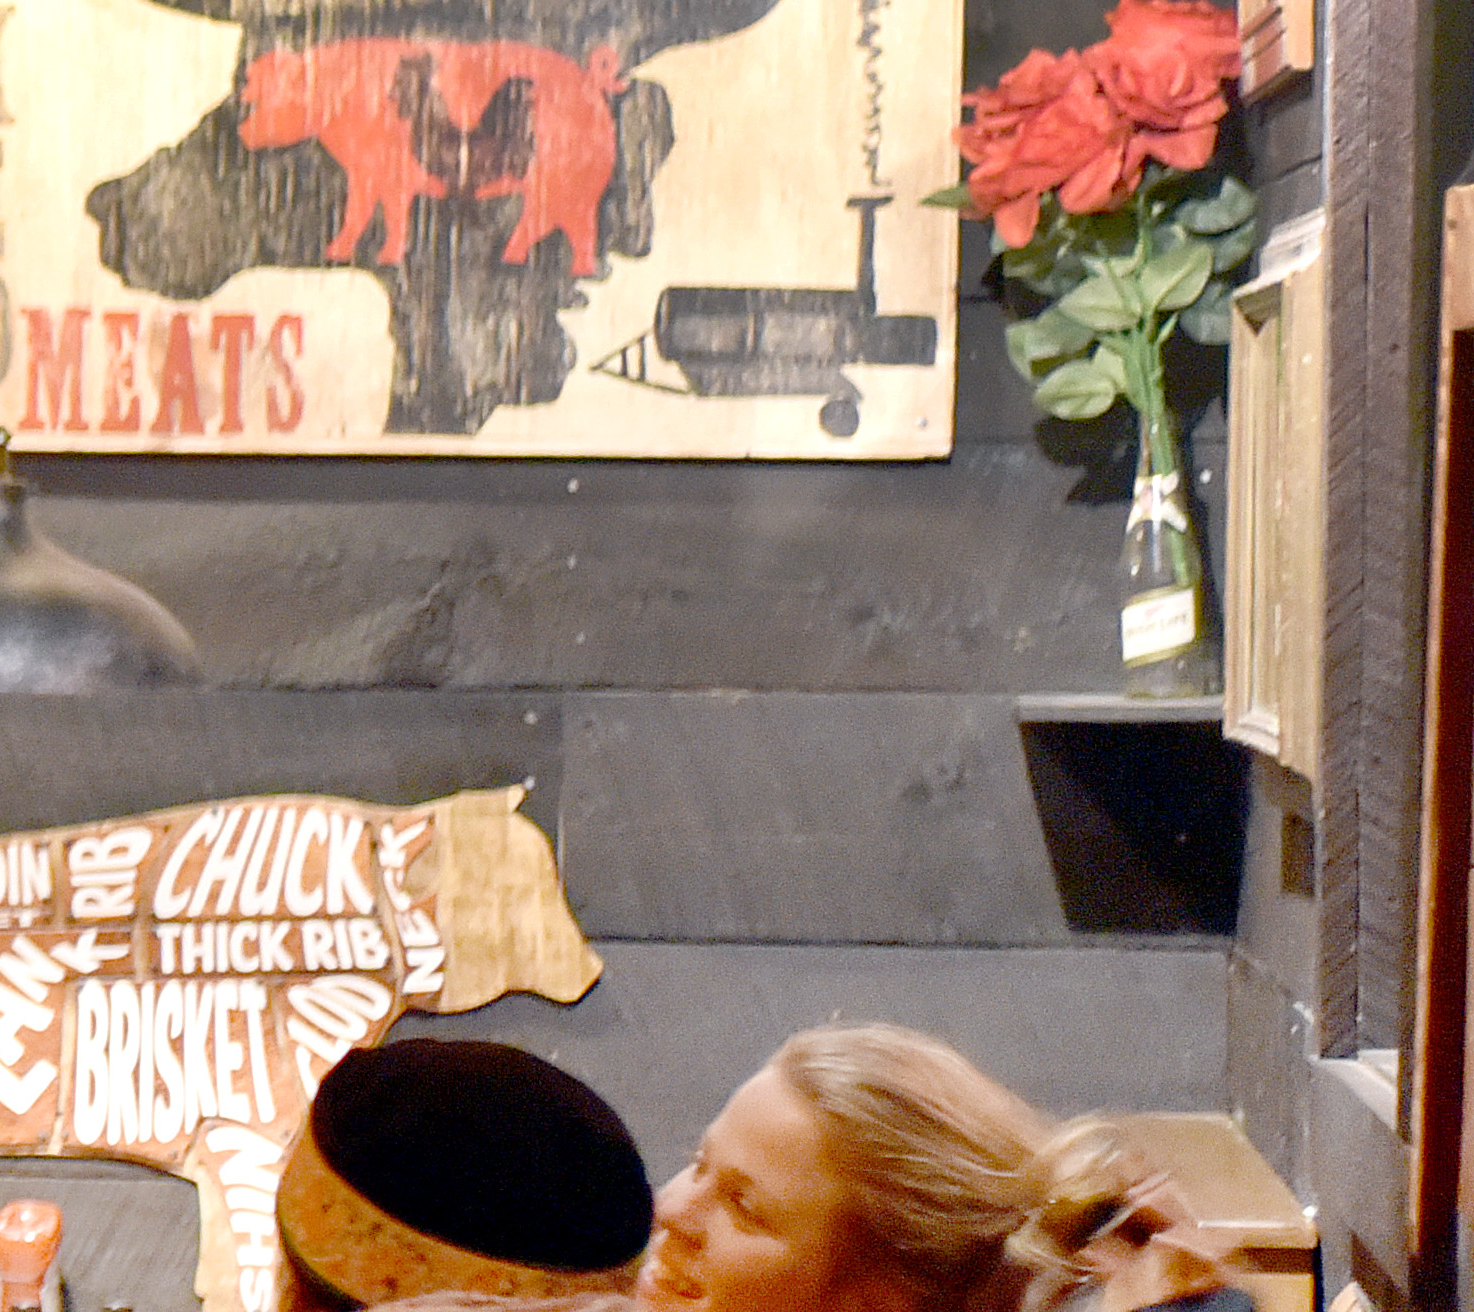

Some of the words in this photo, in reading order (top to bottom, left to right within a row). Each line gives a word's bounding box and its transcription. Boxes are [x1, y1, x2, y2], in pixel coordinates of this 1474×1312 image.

[17, 307, 305, 435] MEATS
[70, 826, 153, 919] RIB
[153, 807, 375, 919] CHUCK
[378, 816, 446, 995] NECK
[155, 921, 296, 975] THICK
[301, 918, 391, 972] RIB
[72, 978, 276, 1145] BRISKET
